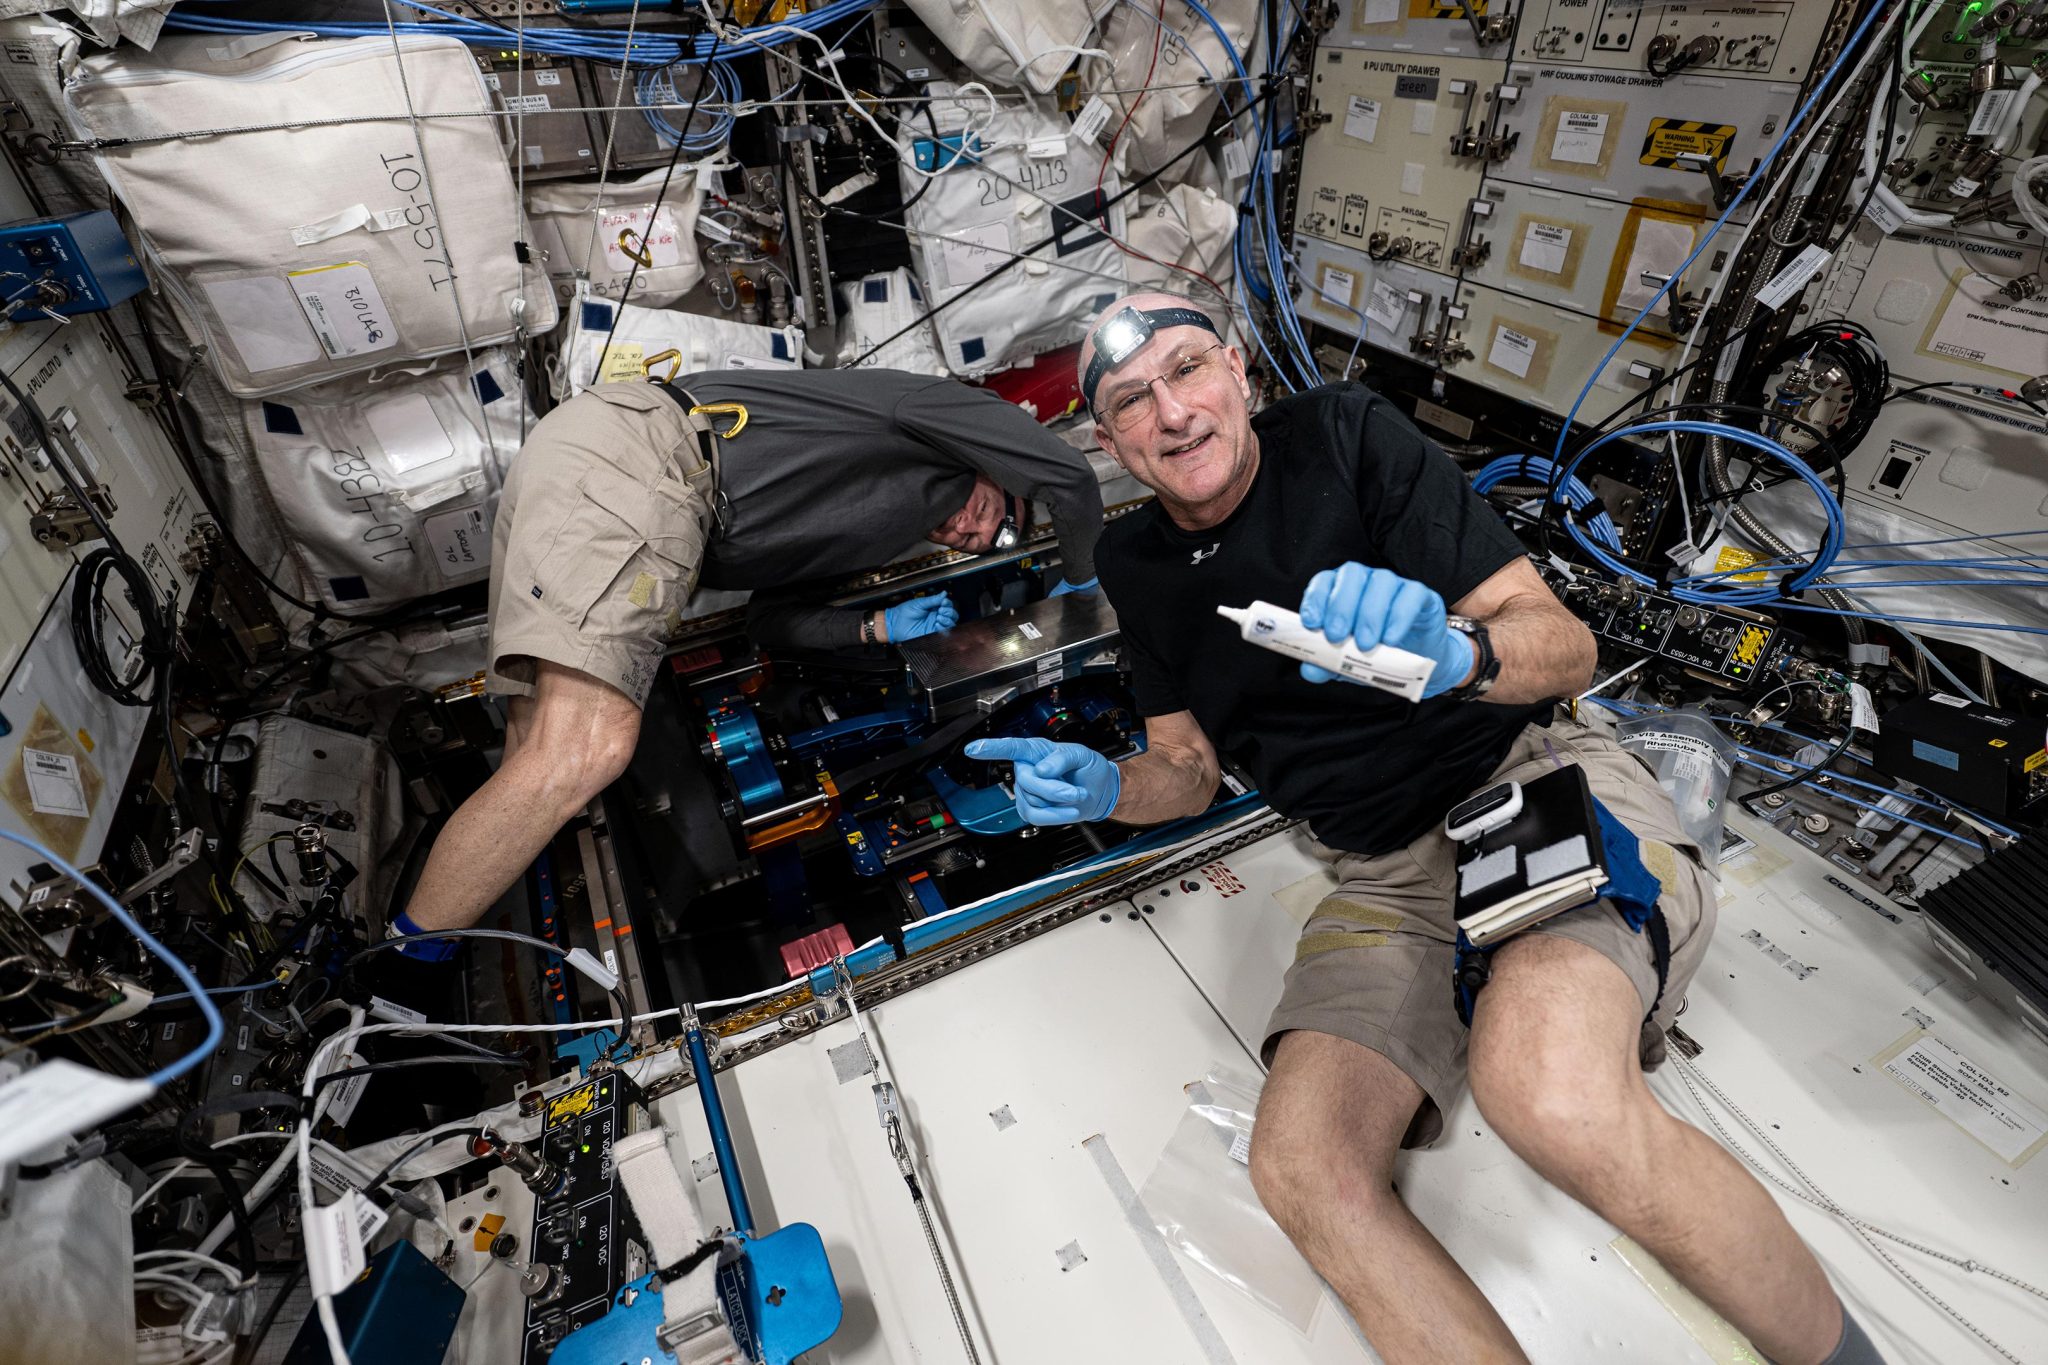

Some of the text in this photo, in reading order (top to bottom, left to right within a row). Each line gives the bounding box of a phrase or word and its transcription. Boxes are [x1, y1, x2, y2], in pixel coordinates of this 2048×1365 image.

[1369, 62, 1378, 71] PU
[1380, 63, 1406, 73] UTILITY
[1407, 66, 1440, 76] DRAWER
[1540, 70, 1553, 79] HRF
[1589, 74, 1626, 85] STOWAGE
[1628, 77, 1663, 88] DRAWER
[1399, 79, 1427, 94] Green
[1664, 133, 1695, 143] WARNING
[1401, 206, 1428, 218] PAYLOAD
[1965, 242, 2023, 260] CONTAINER
[1982, 300, 2011, 311] FACILITY
[1966, 313, 1980, 321] EPM
[1980, 315, 1998, 325] Facility
[1999, 319, 2021, 330] Support
[1930, 397, 1956, 409] POWER
[1957, 404, 2008, 423] DISTRIBUTION
[2009, 418, 2027, 429] UNIT
[1913, 445, 1931, 456] POWER
[1660, 607, 1672, 615] OFF
[1722, 625, 1735, 633] OFF
[1621, 632, 1644, 645] 120 VDC
[1769, 658, 1777, 671] MAX
[1775, 637, 1788, 658] INPUT
[1702, 659, 1713, 668] 120
[1737, 661, 1753, 670] POWER
[1646, 740, 1697, 753] Rheolube
[1660, 732, 1710, 749] Assembly
[1712, 748, 1721, 761] Kit
[1906, 1057, 1965, 1100] Spare Labels 40
[1911, 1054, 1928, 1072] FDIR
[1930, 1069, 1949, 1087] Brush
[1950, 1081, 1968, 1097] Valve
[1968, 1096, 1984, 1109] tool
[1915, 1051, 1932, 1065] FDIR
[1932, 1063, 1959, 1084] Stepper
[1959, 1081, 1978, 1098] Valve
[1978, 1096, 1993, 1109] tool
[1957, 1069, 1995, 1096] SOFT BAG
[1960, 1061, 2010, 1098] COL1D3_B2
[593, 1101, 600, 1109] ON
[584, 1125, 592, 1136] ON
[602, 1121, 611, 1134] 120
[579, 1216, 587, 1229] ON
[562, 1243, 570, 1261] SW2
[598, 1225, 607, 1266] 120 VDC
[563, 1274, 570, 1285] J2
[726, 1286, 741, 1318] LATCH
[734, 1317, 748, 1346] LOCK
